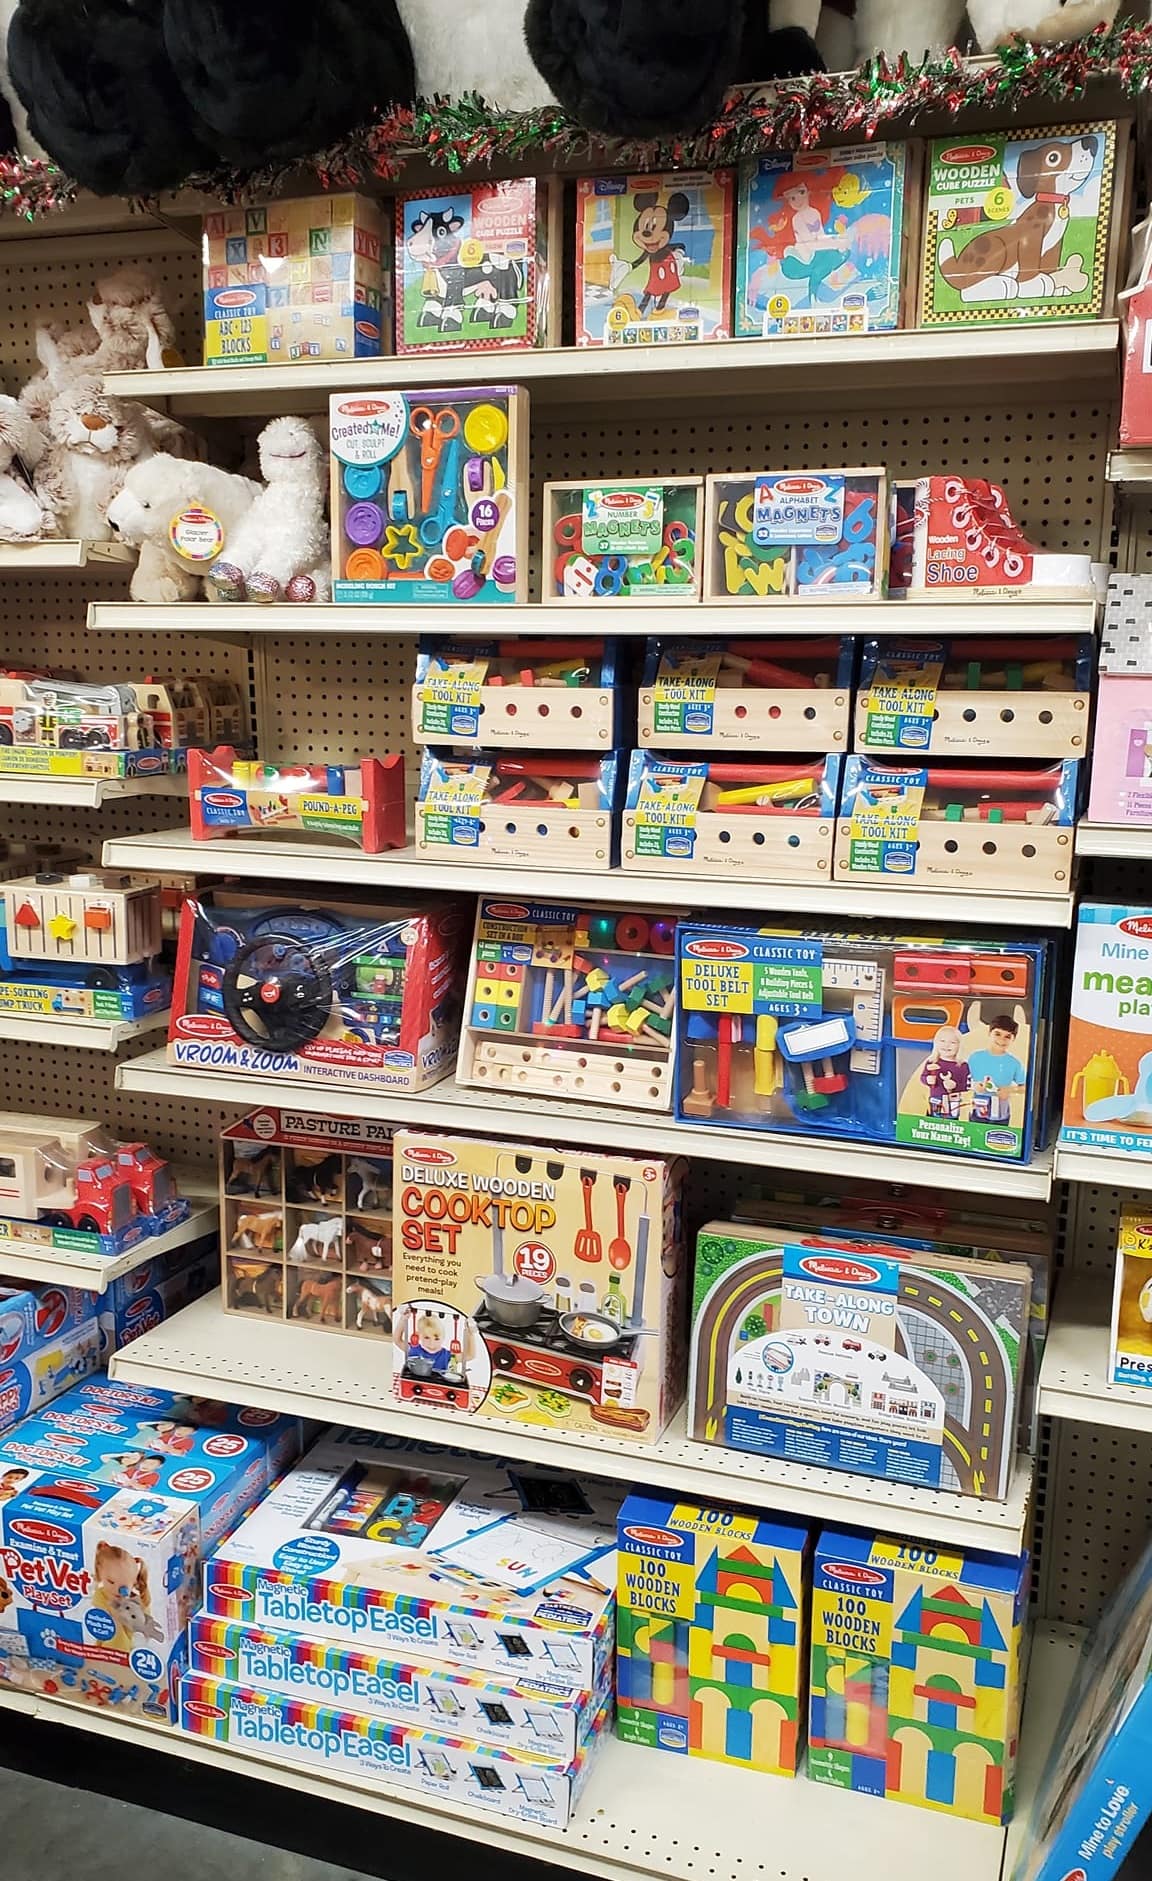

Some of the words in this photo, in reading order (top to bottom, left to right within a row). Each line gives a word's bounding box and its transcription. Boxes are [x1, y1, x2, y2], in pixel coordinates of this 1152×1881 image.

[762, 158, 791, 170] Disney
[934, 164, 1000, 180] WOODEN
[599, 180, 626, 192] Disney
[936, 180, 960, 190] CUBE
[962, 178, 996, 189] PUZZLE
[955, 197, 975, 205] PETS
[994, 191, 1004, 205] 6
[474, 214, 526, 228] WOODEN
[776, 298, 782, 308] 6
[615, 311, 622, 320] 6
[219, 320, 232, 336] ABC
[221, 338, 251, 354] BLOCKS
[331, 423, 370, 441] Created
[381, 424, 400, 438] Me!
[479, 504, 493, 517] 16
[756, 506, 841, 525] MAGNETS
[583, 519, 661, 538] MAGNETS
[928, 534, 958, 544] Wooden
[927, 548, 966, 563] Lacing
[926, 562, 979, 584] Shoe
[427, 677, 480, 692] TAKE-ALONG
[658, 676, 714, 688] TAKE-ALONG
[432, 690, 454, 702] TOOL
[455, 692, 472, 704] KIT
[664, 688, 687, 700] TOOL
[689, 689, 706, 700] KIT
[879, 700, 903, 713] TOOL
[906, 701, 925, 713] KIT
[653, 765, 684, 774] CLASSIC
[687, 767, 703, 775] TOY
[865, 775, 900, 784] CLASSIC
[904, 776, 920, 784] TOY
[429, 790, 480, 803] TAKE-ALONG
[303, 800, 357, 814] POUND-A-PEG
[433, 804, 454, 814] TOOL
[455, 805, 471, 815] KIT
[639, 800, 695, 812] TAKE-ALONG
[644, 812, 667, 824] TOOL
[670, 814, 686, 825] KIT
[861, 827, 886, 838] TOOL
[889, 827, 908, 839] KIT
[532, 909, 560, 921] CLASSIC
[562, 911, 576, 921] TOY
[753, 946, 793, 959] CLASSIC
[797, 949, 816, 960] TOY
[1101, 942, 1149, 960] Mine
[695, 964, 740, 978] DELUXE
[685, 977, 717, 993] TOOL
[720, 980, 749, 994] BELT
[831, 976, 838, 984] 3
[853, 978, 860, 987] 4
[20, 1000, 44, 1011] TRUCK
[706, 994, 728, 1007] SET
[769, 1004, 790, 1013] AGES
[174, 1043, 239, 1069] VROOM
[251, 1048, 301, 1073] ZOOM
[303, 1064, 356, 1081] INTERACTIVE
[358, 1071, 410, 1086] DASHBOARD
[284, 1115, 361, 1136] PASTURE
[366, 1125, 394, 1140] PAL
[918, 1119, 965, 1134] Personalize
[911, 1130, 930, 1141] Your
[930, 1132, 953, 1143] Name
[953, 1134, 971, 1148] Tag!
[1066, 1131, 1089, 1141] IT'S
[1090, 1132, 1116, 1144] TIME
[1119, 1135, 1133, 1146] TO
[401, 1165, 468, 1189] DELUXE
[472, 1174, 556, 1202] WOODEN
[401, 1186, 557, 1234] COOKTOP
[401, 1220, 462, 1254] SET
[403, 1252, 448, 1268] Everything
[447, 1259, 462, 1268] you
[518, 1247, 550, 1270] 19
[405, 1263, 425, 1274] need
[427, 1265, 436, 1274] to
[438, 1267, 458, 1277] cook
[808, 1260, 843, 1275] Melissa
[851, 1267, 873, 1281] Doug
[406, 1274, 458, 1290] pretend-play
[417, 1285, 444, 1296] meals!
[784, 1284, 895, 1316] TAKE-ALONG
[804, 1306, 871, 1333] TOWN
[104, 1424, 124, 1434] KIT
[215, 1438, 240, 1450] 25
[67, 1455, 88, 1466] KIT
[183, 1472, 208, 1485] 25
[16, 1522, 45, 1537] Melissa
[669, 1518, 712, 1532] WOODEN
[716, 1527, 752, 1540] BLOCKS
[9, 1539, 47, 1554] Examine
[56, 1549, 79, 1561] Treat
[625, 1544, 662, 1558] CLASSIC
[664, 1549, 681, 1560] TOY
[2, 1548, 45, 1589] Pet
[46, 1556, 91, 1596] Vet
[496, 1557, 538, 1578] SUN
[639, 1559, 666, 1577] 100
[870, 1554, 915, 1571] WOODEN
[919, 1564, 959, 1580] BLOCKS
[257, 1578, 308, 1598] Magnetic
[625, 1573, 681, 1598] WOODEN
[822, 1579, 863, 1595] CLASSIC
[865, 1586, 884, 1599] TOY
[22, 1585, 50, 1603] Play
[50, 1593, 72, 1609] Set
[630, 1590, 676, 1613] BLOCKS
[837, 1597, 866, 1616] 100
[369, 1607, 438, 1640] Easel
[536, 1611, 588, 1627] PEDIATRICS
[822, 1610, 881, 1636] WOODEN
[239, 1639, 291, 1657] Magnetic
[826, 1630, 876, 1653] BLOCKS
[136, 1654, 156, 1668] 24
[352, 1668, 420, 1705] Easel
[518, 1680, 571, 1697] PEDIATRICS
[231, 1698, 281, 1716] Magnetic
[343, 1729, 411, 1766] Easel
[1077, 1825, 1104, 1862] Mine
[1096, 1813, 1111, 1834] to
[1107, 1784, 1130, 1818] Love
[1102, 1834, 1124, 1861] play
[1113, 1801, 1140, 1841] stroller
